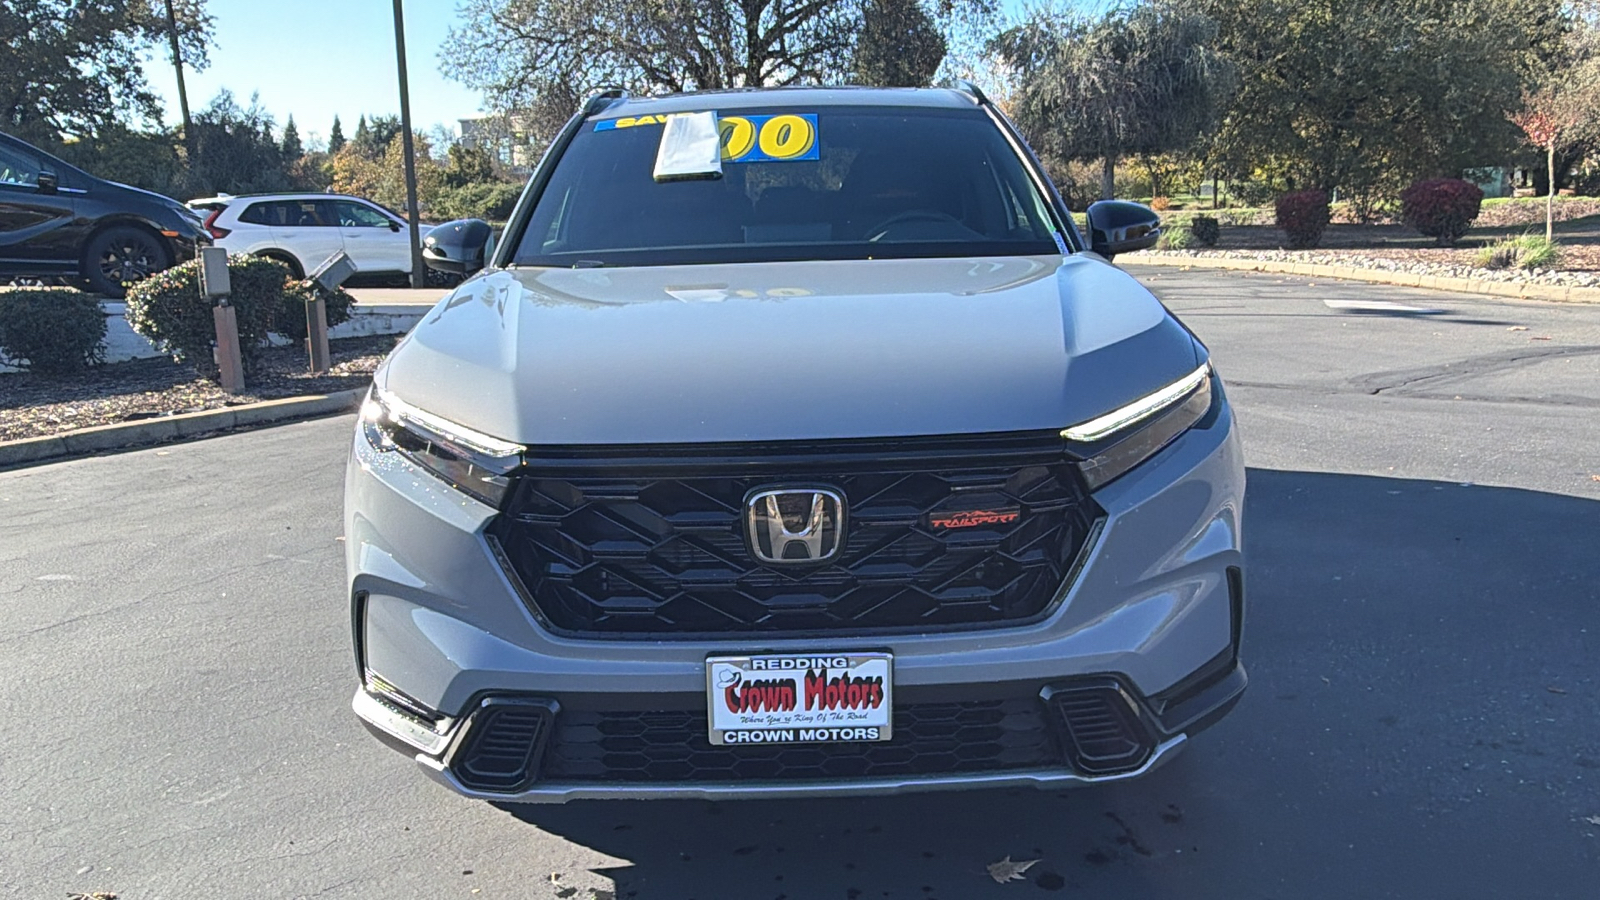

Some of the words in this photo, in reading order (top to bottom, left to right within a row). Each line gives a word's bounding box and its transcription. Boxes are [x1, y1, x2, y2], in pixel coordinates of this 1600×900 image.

[931, 513, 1018, 528] TRAILSPORT
[752, 657, 848, 670] REDDING
[725, 671, 797, 714] Crown
[804, 668, 884, 712] Motors
[740, 715, 764, 724] Where
[794, 713, 814, 723] King
[816, 712, 828, 722] Of
[830, 712, 844, 720] The
[847, 711, 869, 720] Road
[724, 730, 794, 743] CROWN
[800, 728, 879, 741] MOTORS
